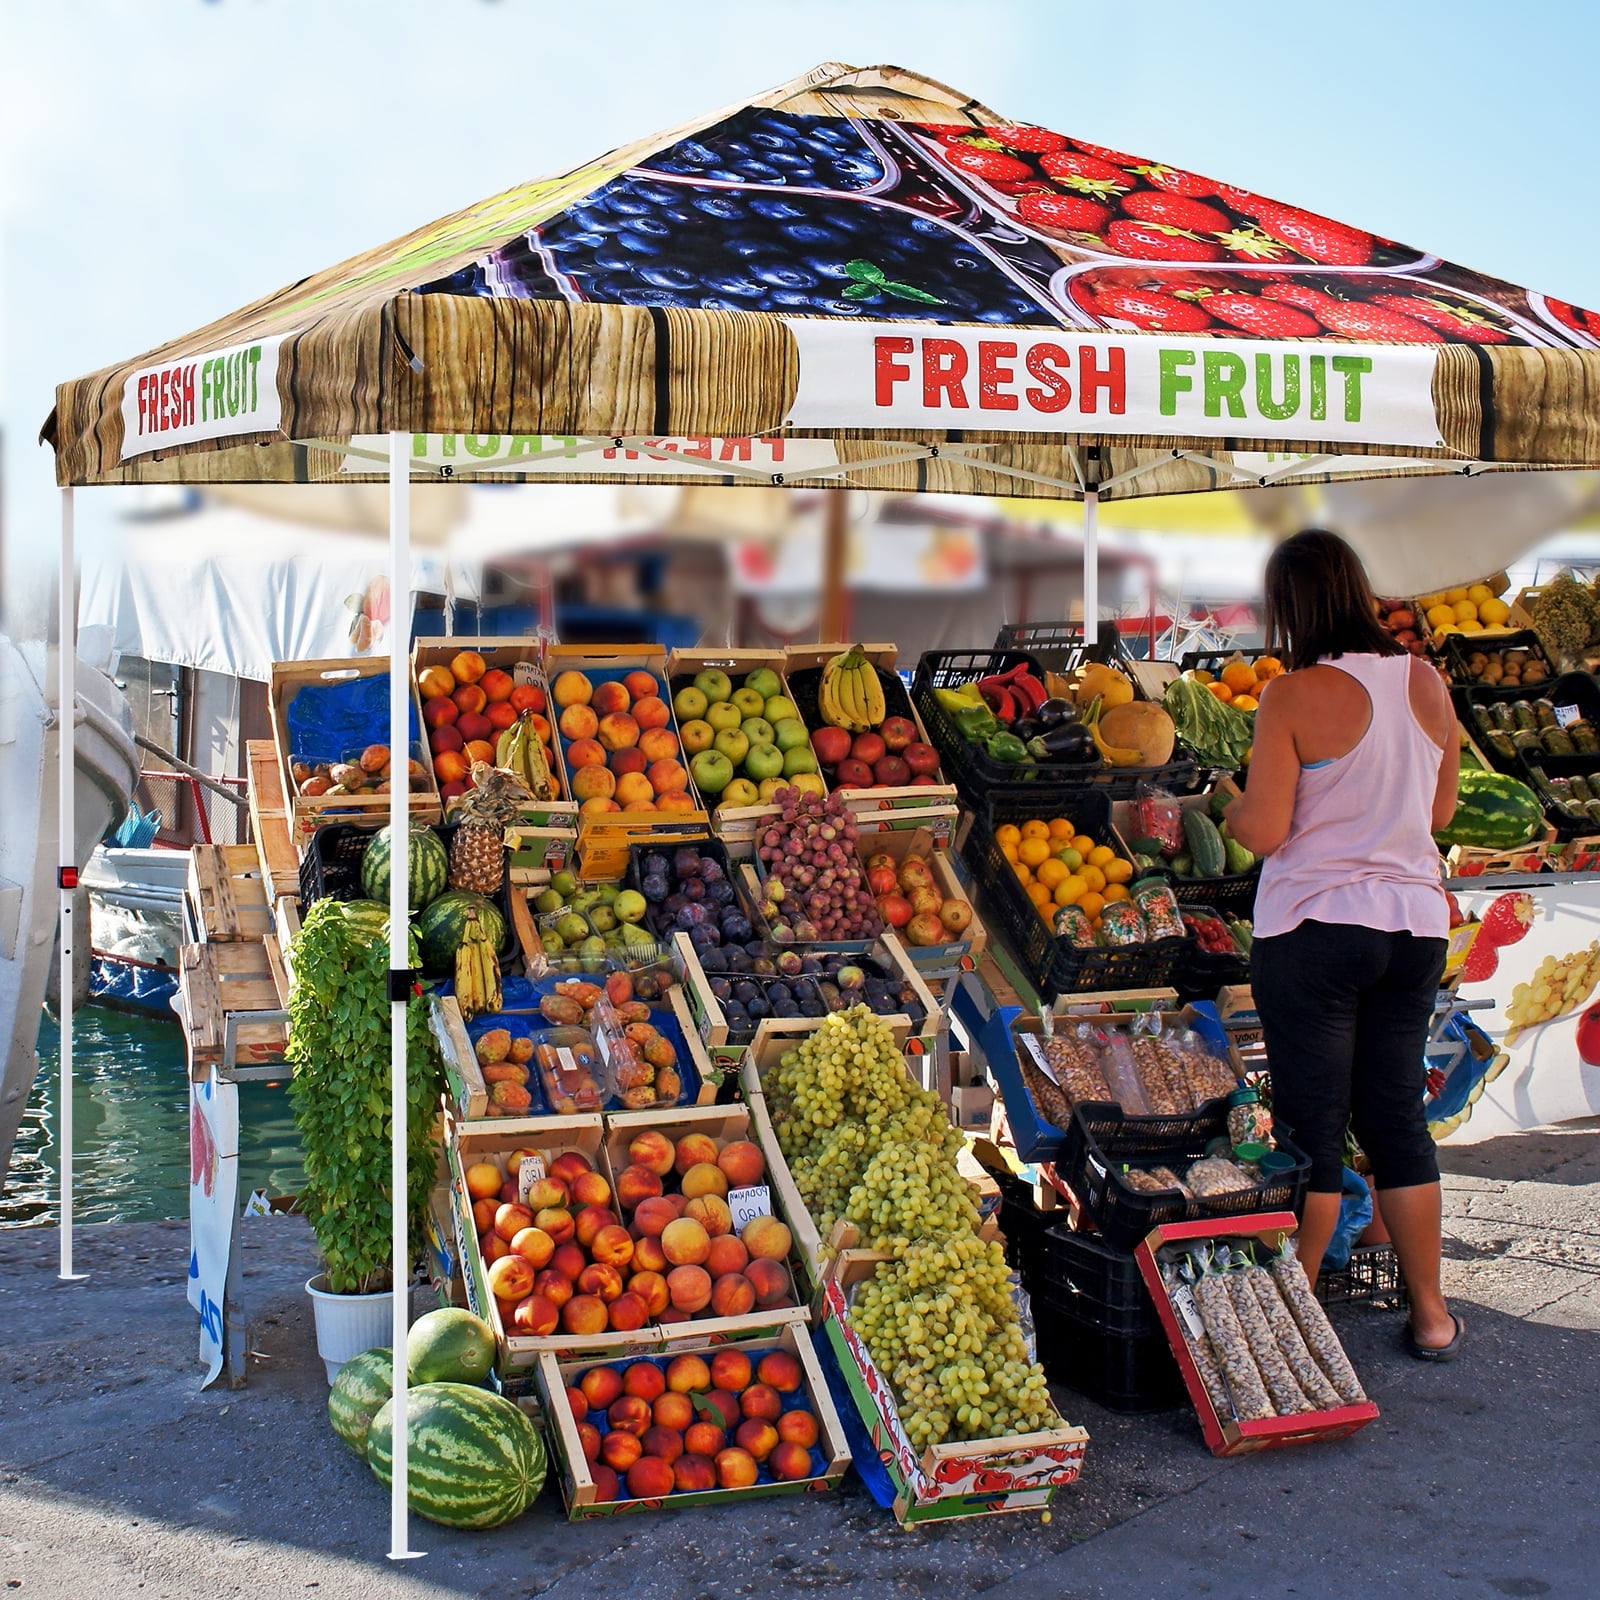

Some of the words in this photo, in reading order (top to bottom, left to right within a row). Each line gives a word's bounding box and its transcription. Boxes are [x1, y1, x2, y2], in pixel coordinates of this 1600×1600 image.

[138, 364, 197, 436] FRESH
[201, 345, 261, 422] FRUIT
[874, 336, 1126, 415] FRESH
[1158, 349, 1373, 423] FRUIT
